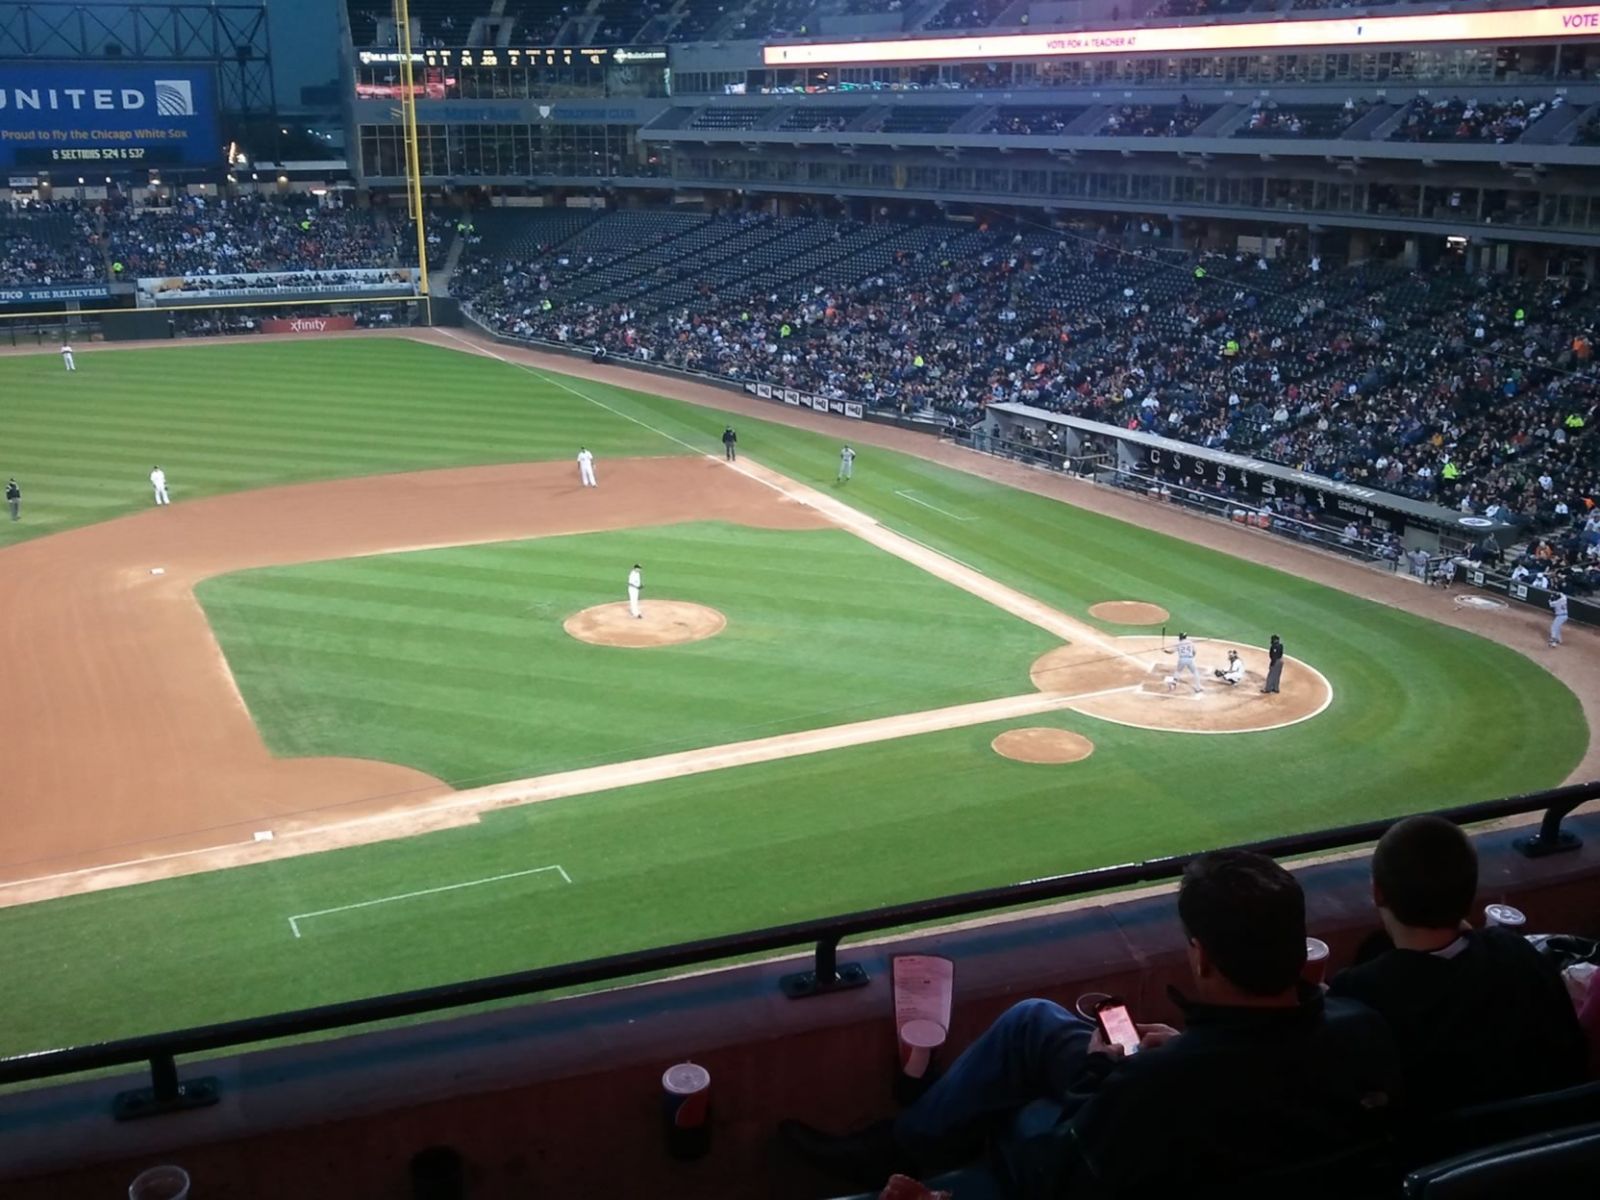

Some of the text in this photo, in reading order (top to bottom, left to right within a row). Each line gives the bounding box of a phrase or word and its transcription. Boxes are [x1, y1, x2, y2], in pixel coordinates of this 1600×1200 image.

[1562, 14, 1598, 28] VOTE
[1, 128, 188, 140] Proud to fly the Chicago White Sox
[29, 288, 108, 300] THE RELIEVERS
[290, 320, 326, 332] xfinity
